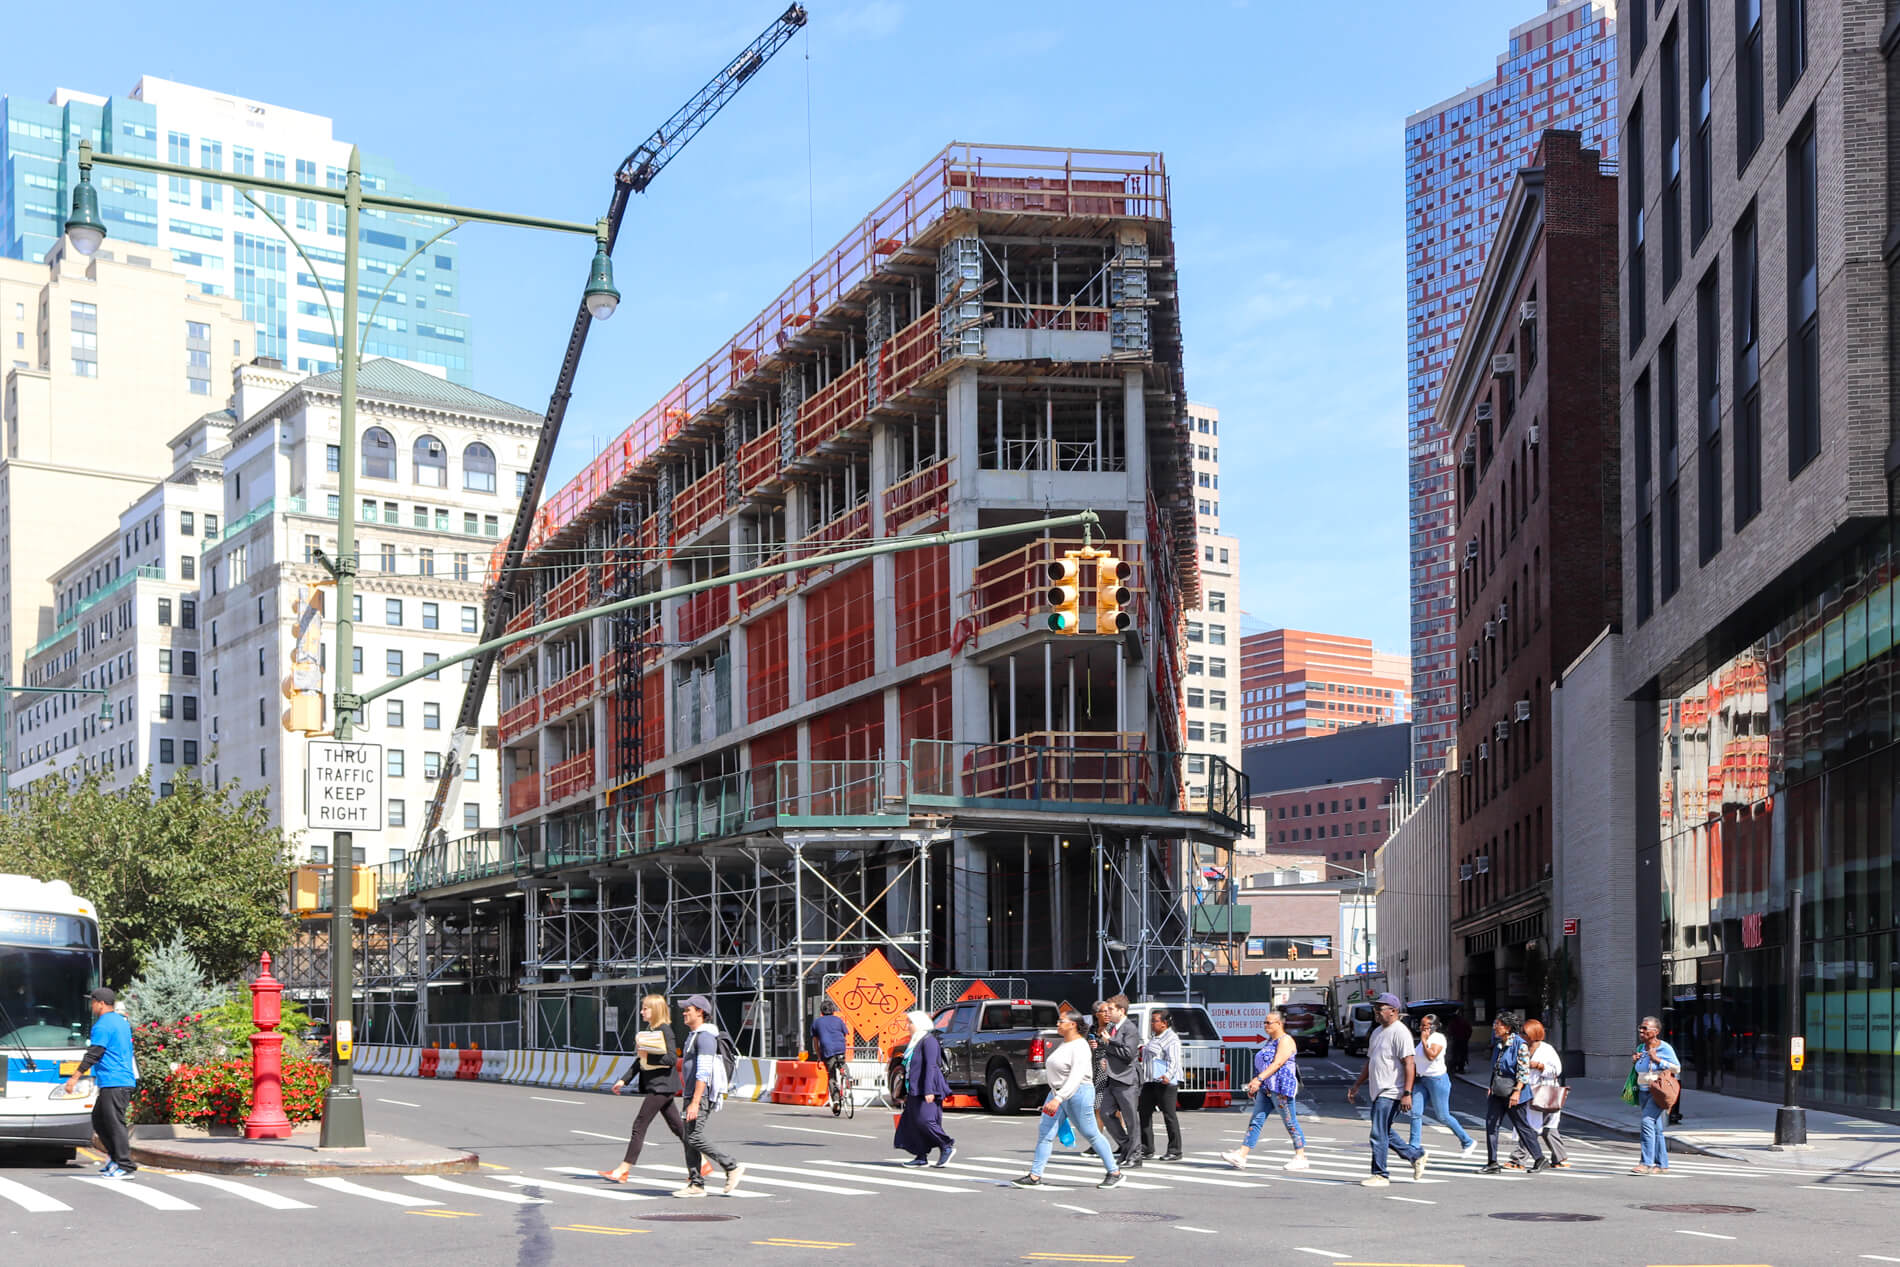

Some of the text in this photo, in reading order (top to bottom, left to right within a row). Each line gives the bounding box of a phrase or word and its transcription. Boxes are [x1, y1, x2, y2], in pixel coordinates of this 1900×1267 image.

[324, 748, 367, 764] THRU
[316, 767, 374, 783] TRAFFIC
[324, 786, 366, 801] KEEP
[320, 806, 368, 821] RIGHT
[1211, 1008, 1266, 1017] SIDEWALK CLOSED
[1228, 1020, 1248, 1029] OTHER
[1249, 1020, 1264, 1029] SIDE
